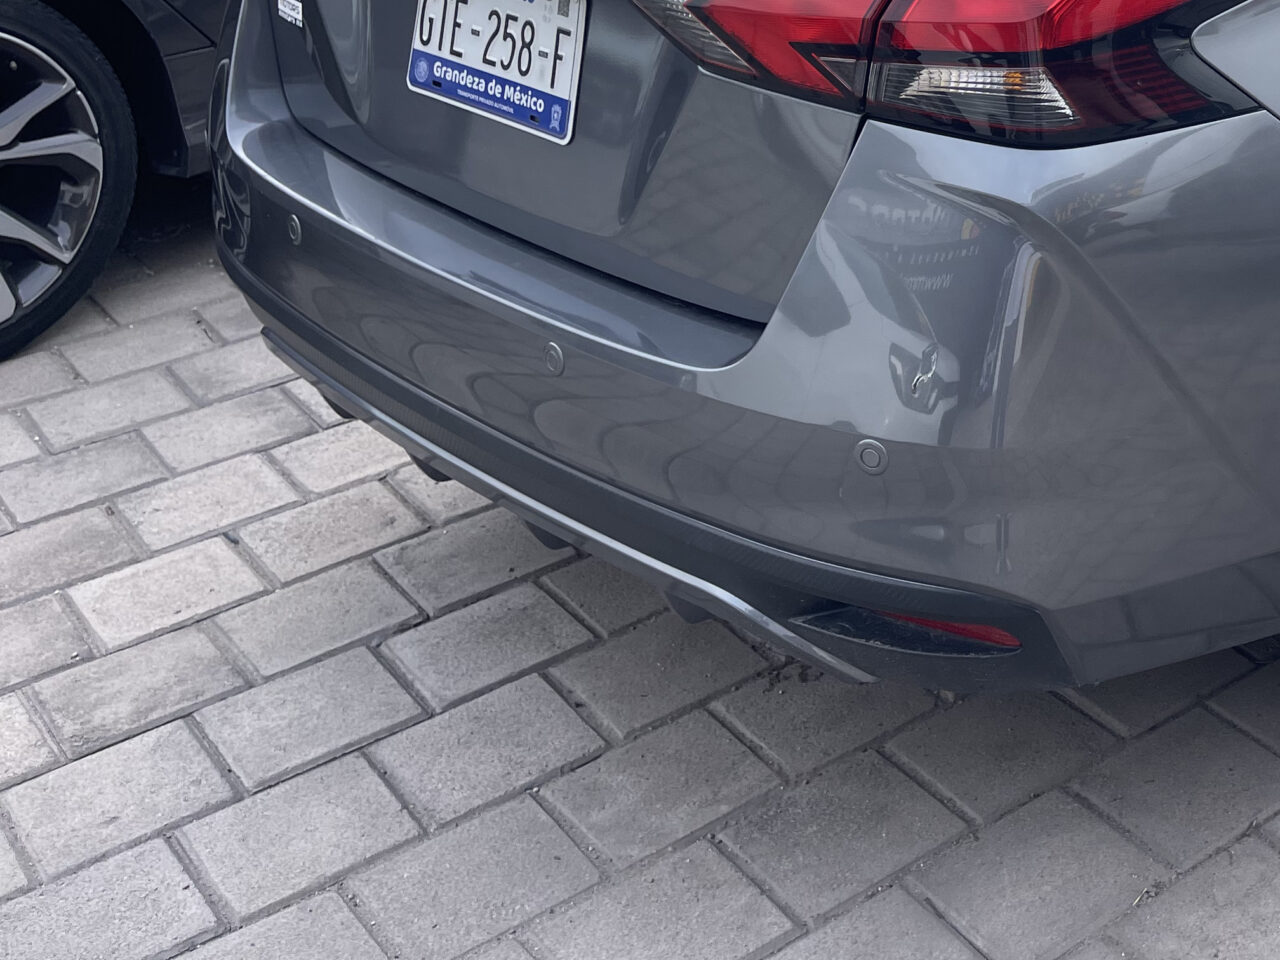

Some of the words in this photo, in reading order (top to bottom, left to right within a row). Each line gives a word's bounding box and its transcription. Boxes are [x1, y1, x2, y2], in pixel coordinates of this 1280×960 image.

[433, 61, 486, 92] Grandeza
[487, 79, 502, 98] de
[503, 84, 545, 113] México
